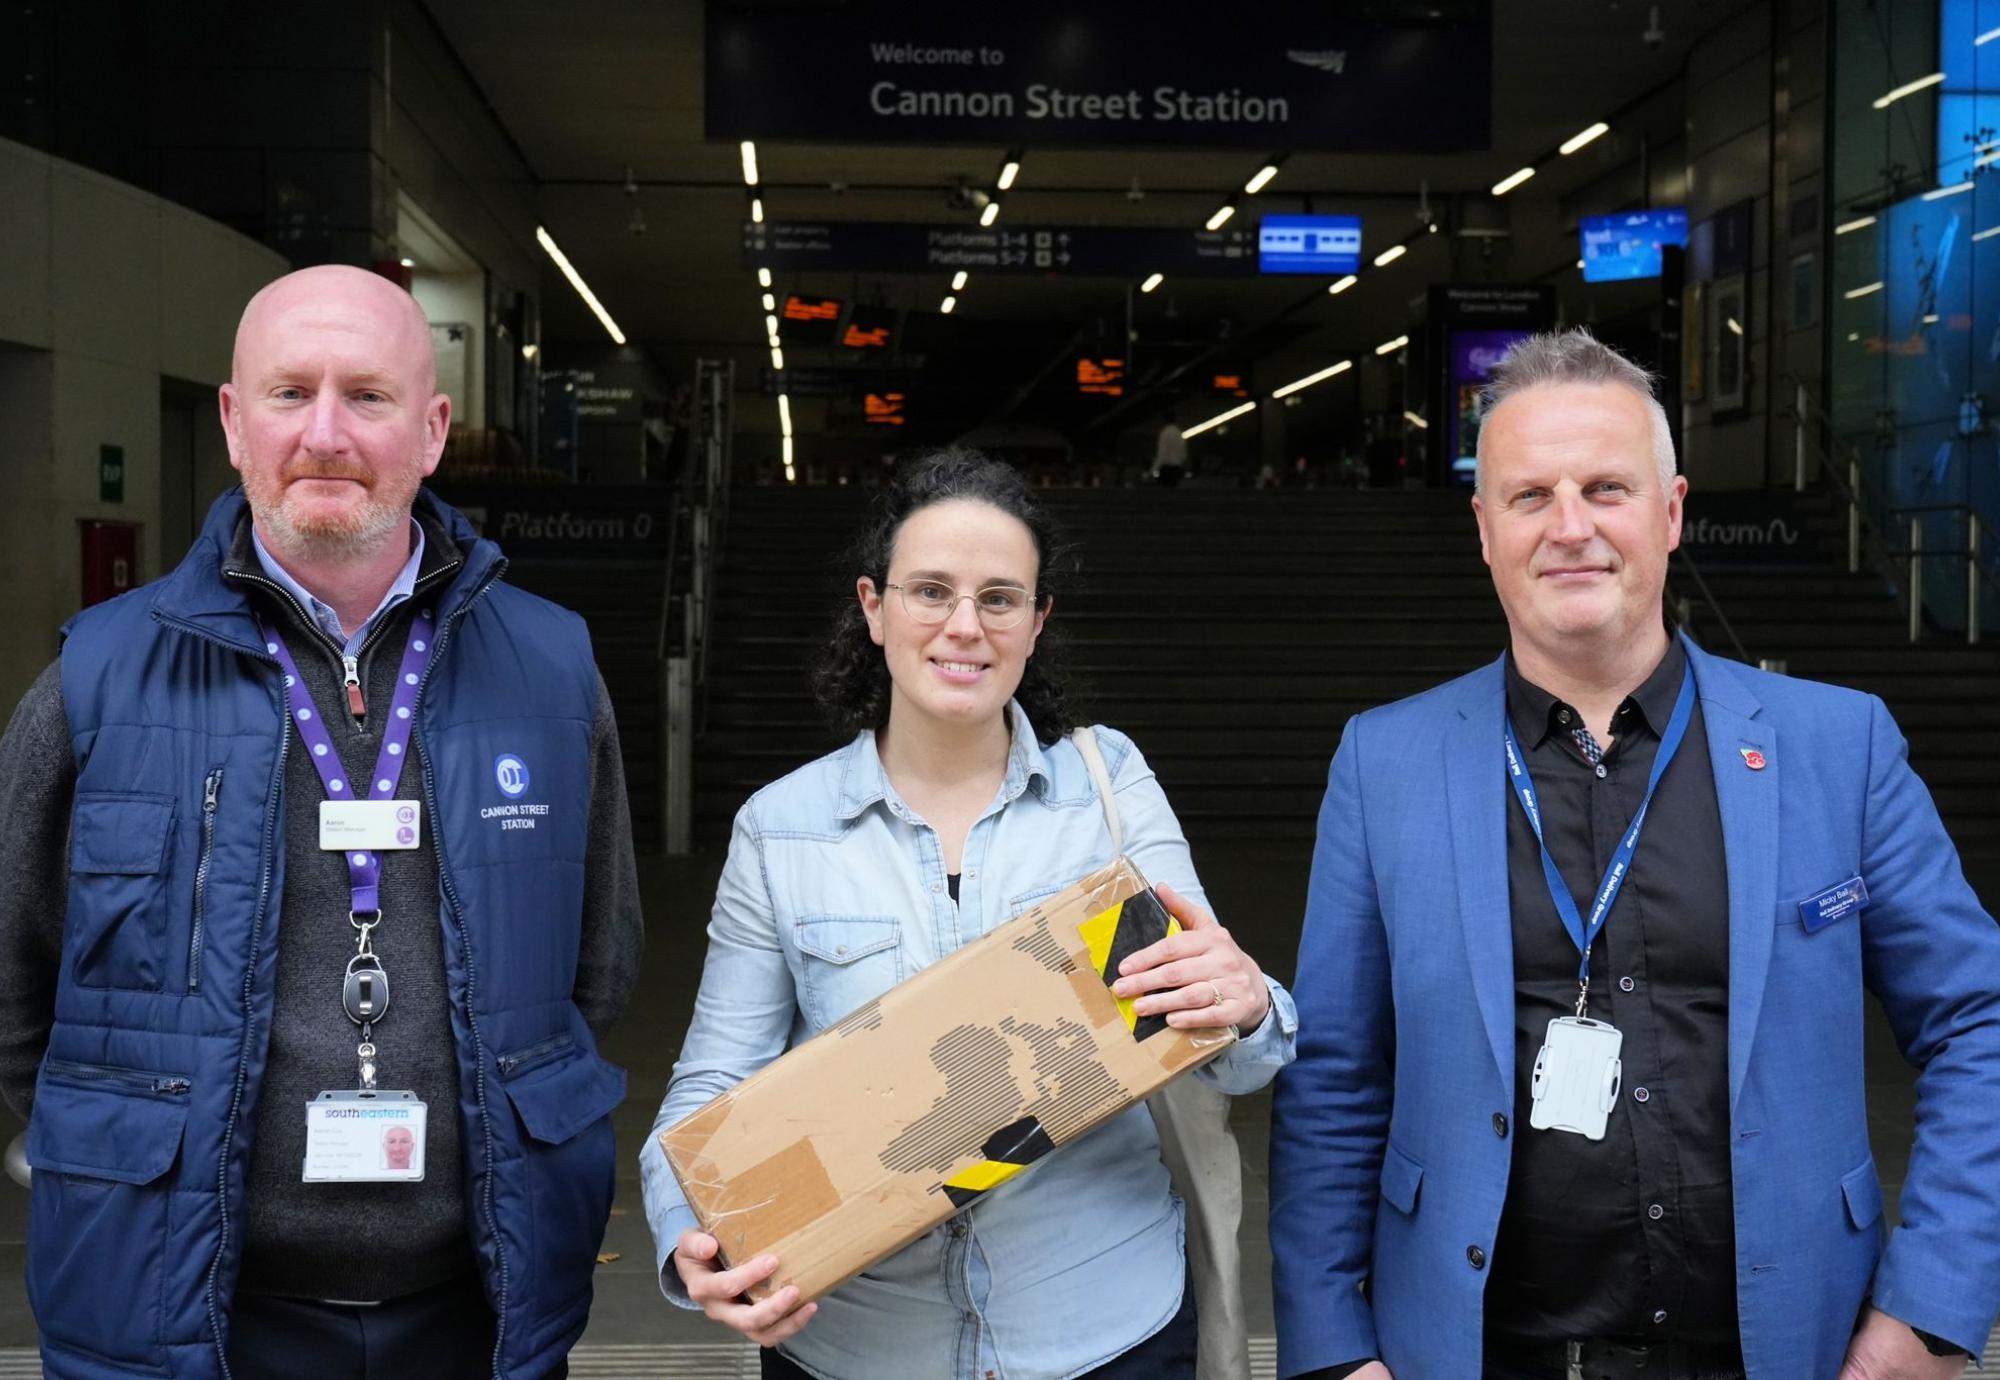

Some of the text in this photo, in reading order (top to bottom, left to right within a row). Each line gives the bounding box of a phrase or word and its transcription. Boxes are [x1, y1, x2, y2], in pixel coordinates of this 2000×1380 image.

[870, 43, 1004, 66] Welcome to
[870, 81, 1288, 123] Cannon Street Station
[928, 230, 997, 247] Platforms
[928, 249, 998, 266] Platforms
[502, 511, 625, 540] Platform
[480, 804, 549, 819] CANNON STREET
[501, 818, 535, 831] STATION
[1613, 862, 1625, 877] Rail
[1599, 875, 1619, 905] Delivery
[325, 1108, 409, 1119] southeastern
